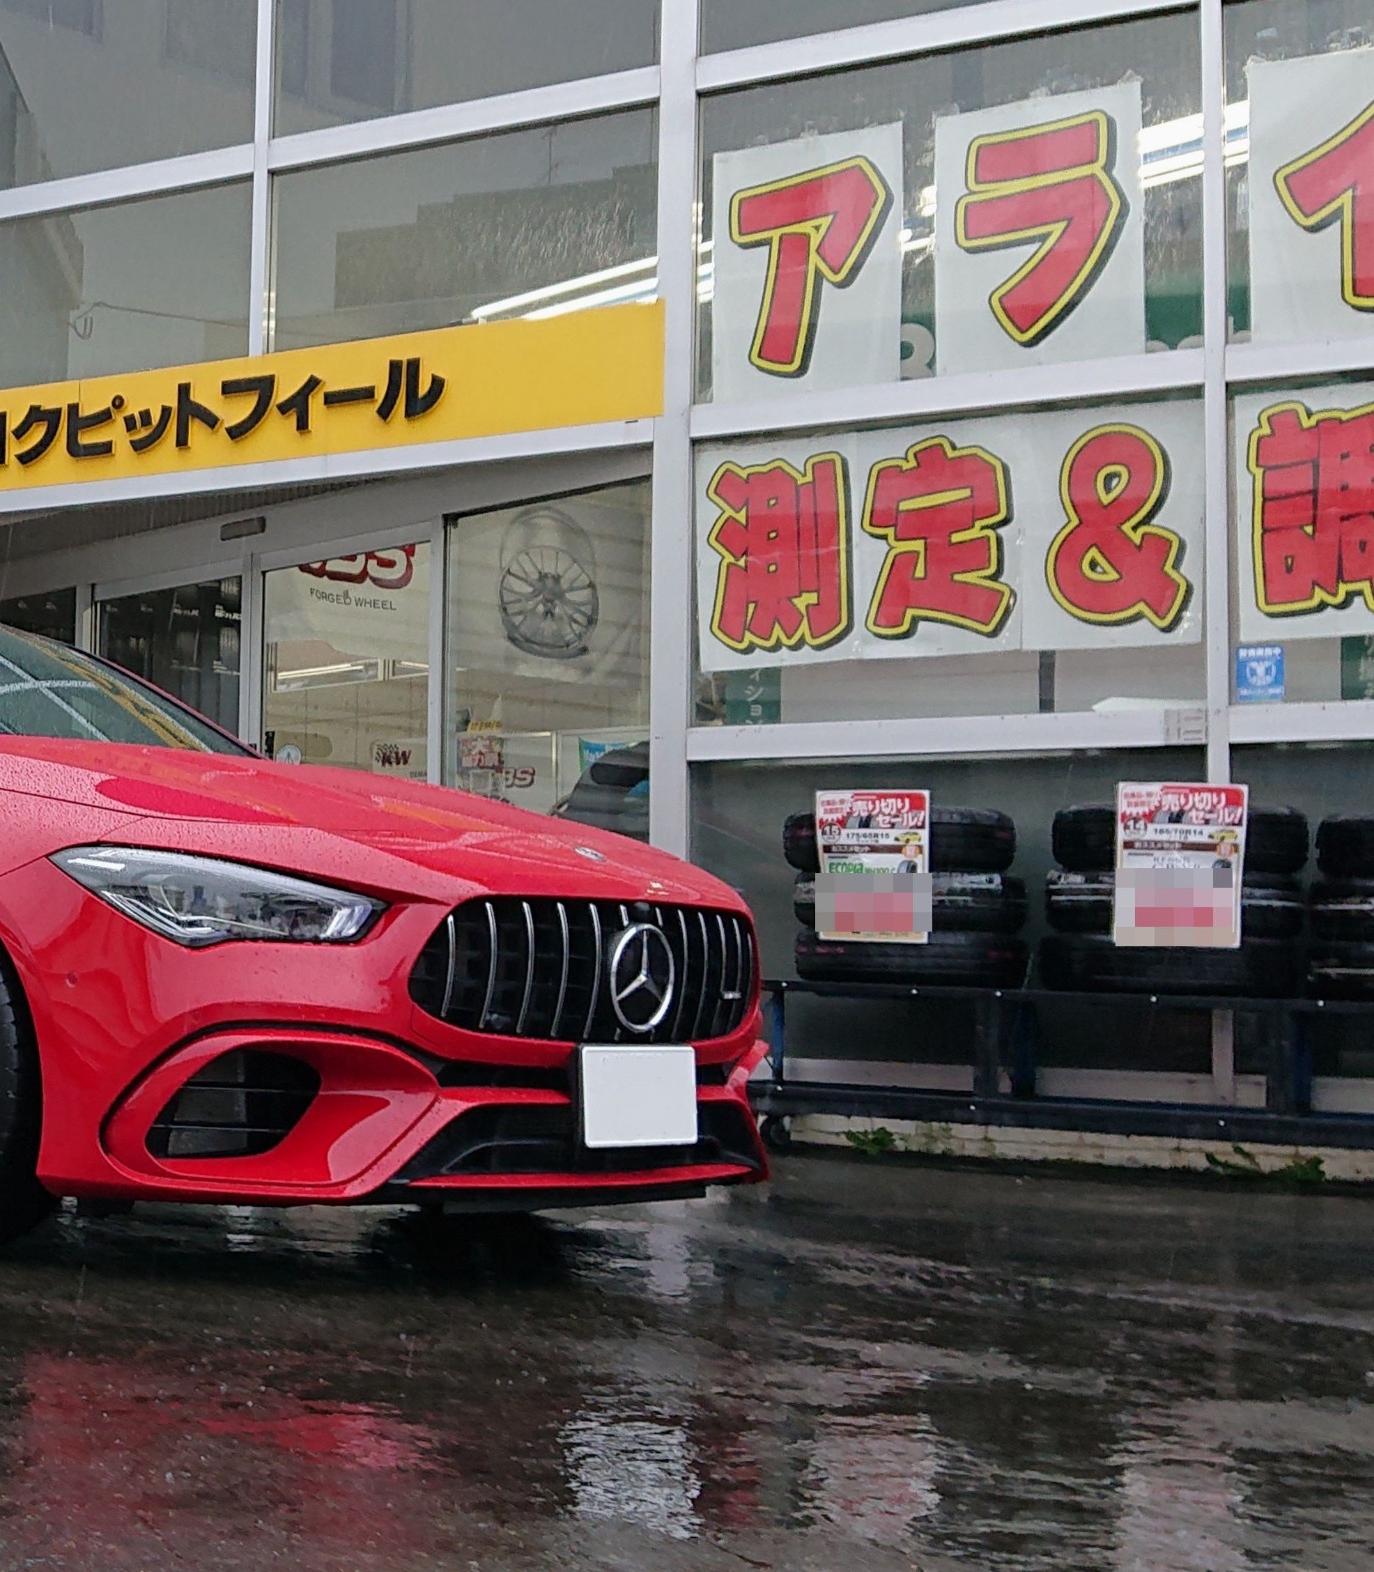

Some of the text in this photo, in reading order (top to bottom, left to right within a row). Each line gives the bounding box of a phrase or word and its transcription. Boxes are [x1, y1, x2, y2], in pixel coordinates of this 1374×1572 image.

[310, 587, 397, 611] FORGED WHEEL
[853, 798, 910, 817] 売り切り
[1162, 792, 1226, 812] 売り切り
[876, 810, 925, 828] セール!
[1189, 807, 1243, 825] セール!
[824, 826, 839, 836] 15
[1128, 820, 1145, 831] 14
